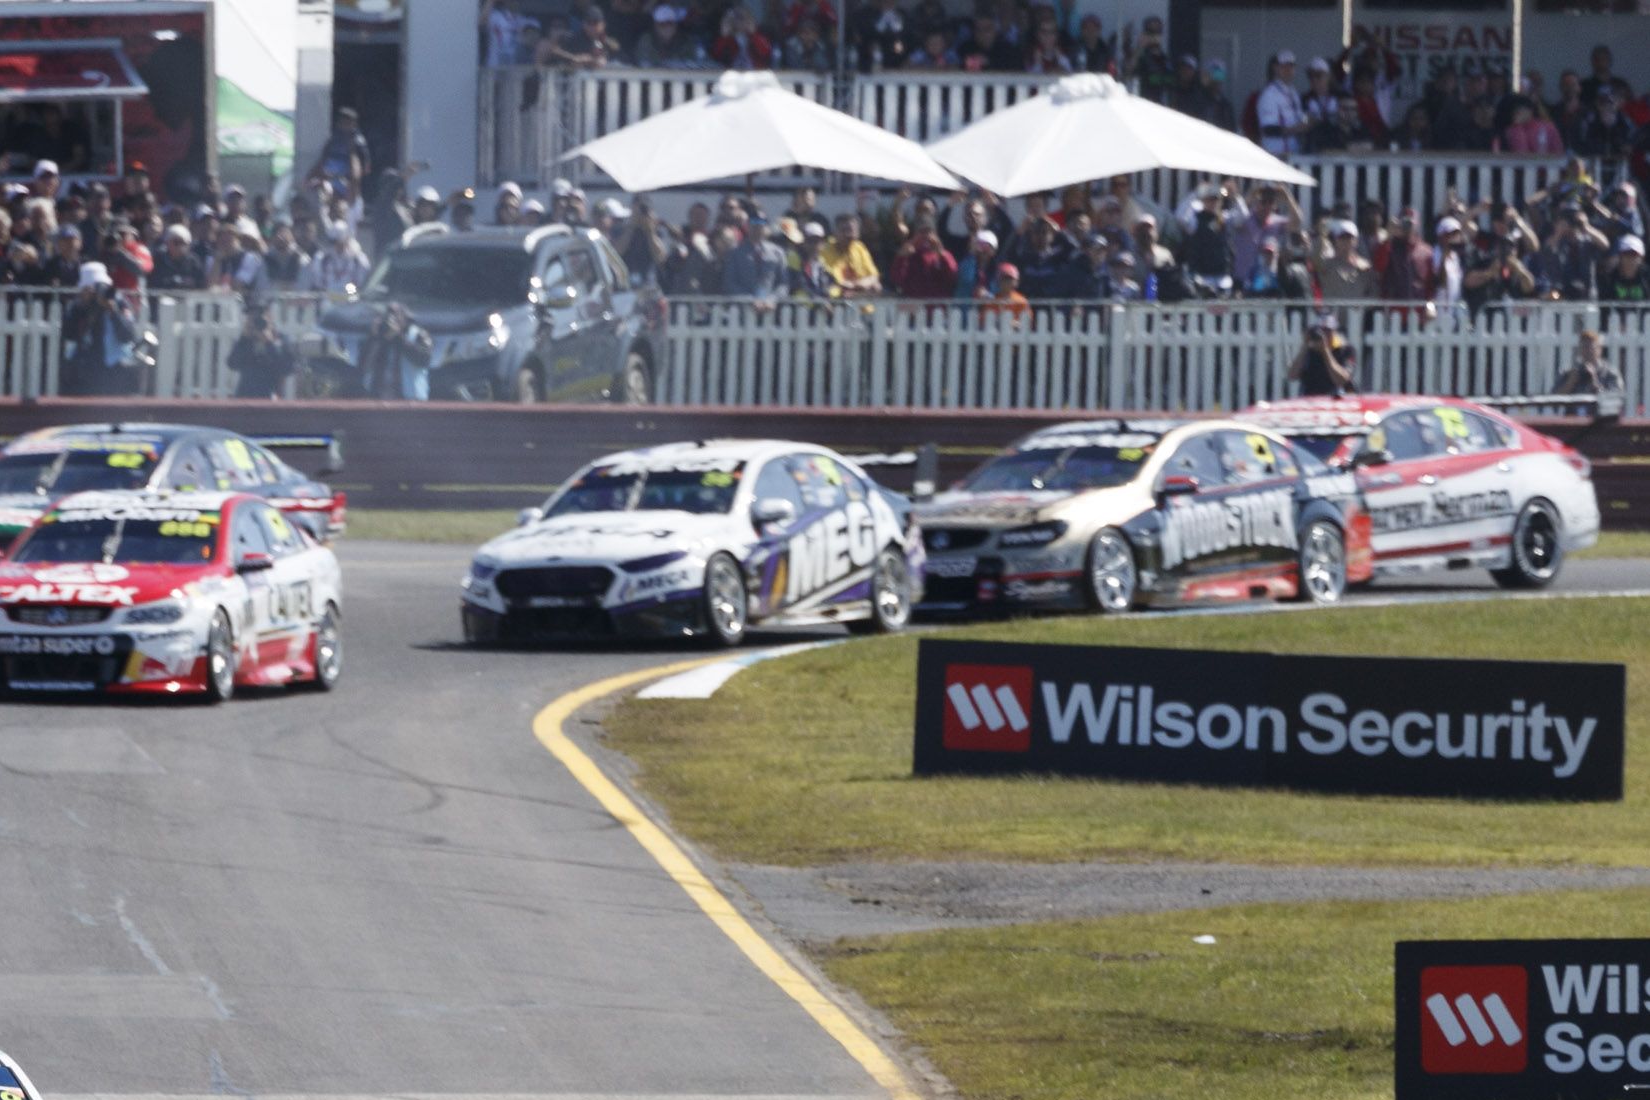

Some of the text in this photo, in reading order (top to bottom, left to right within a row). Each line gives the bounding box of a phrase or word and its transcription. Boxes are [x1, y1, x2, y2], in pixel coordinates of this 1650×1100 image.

[1351, 25, 1513, 50] NISSAN
[1041, 681, 1597, 778] Wilson Security
[1541, 964, 1650, 1014] Wil
